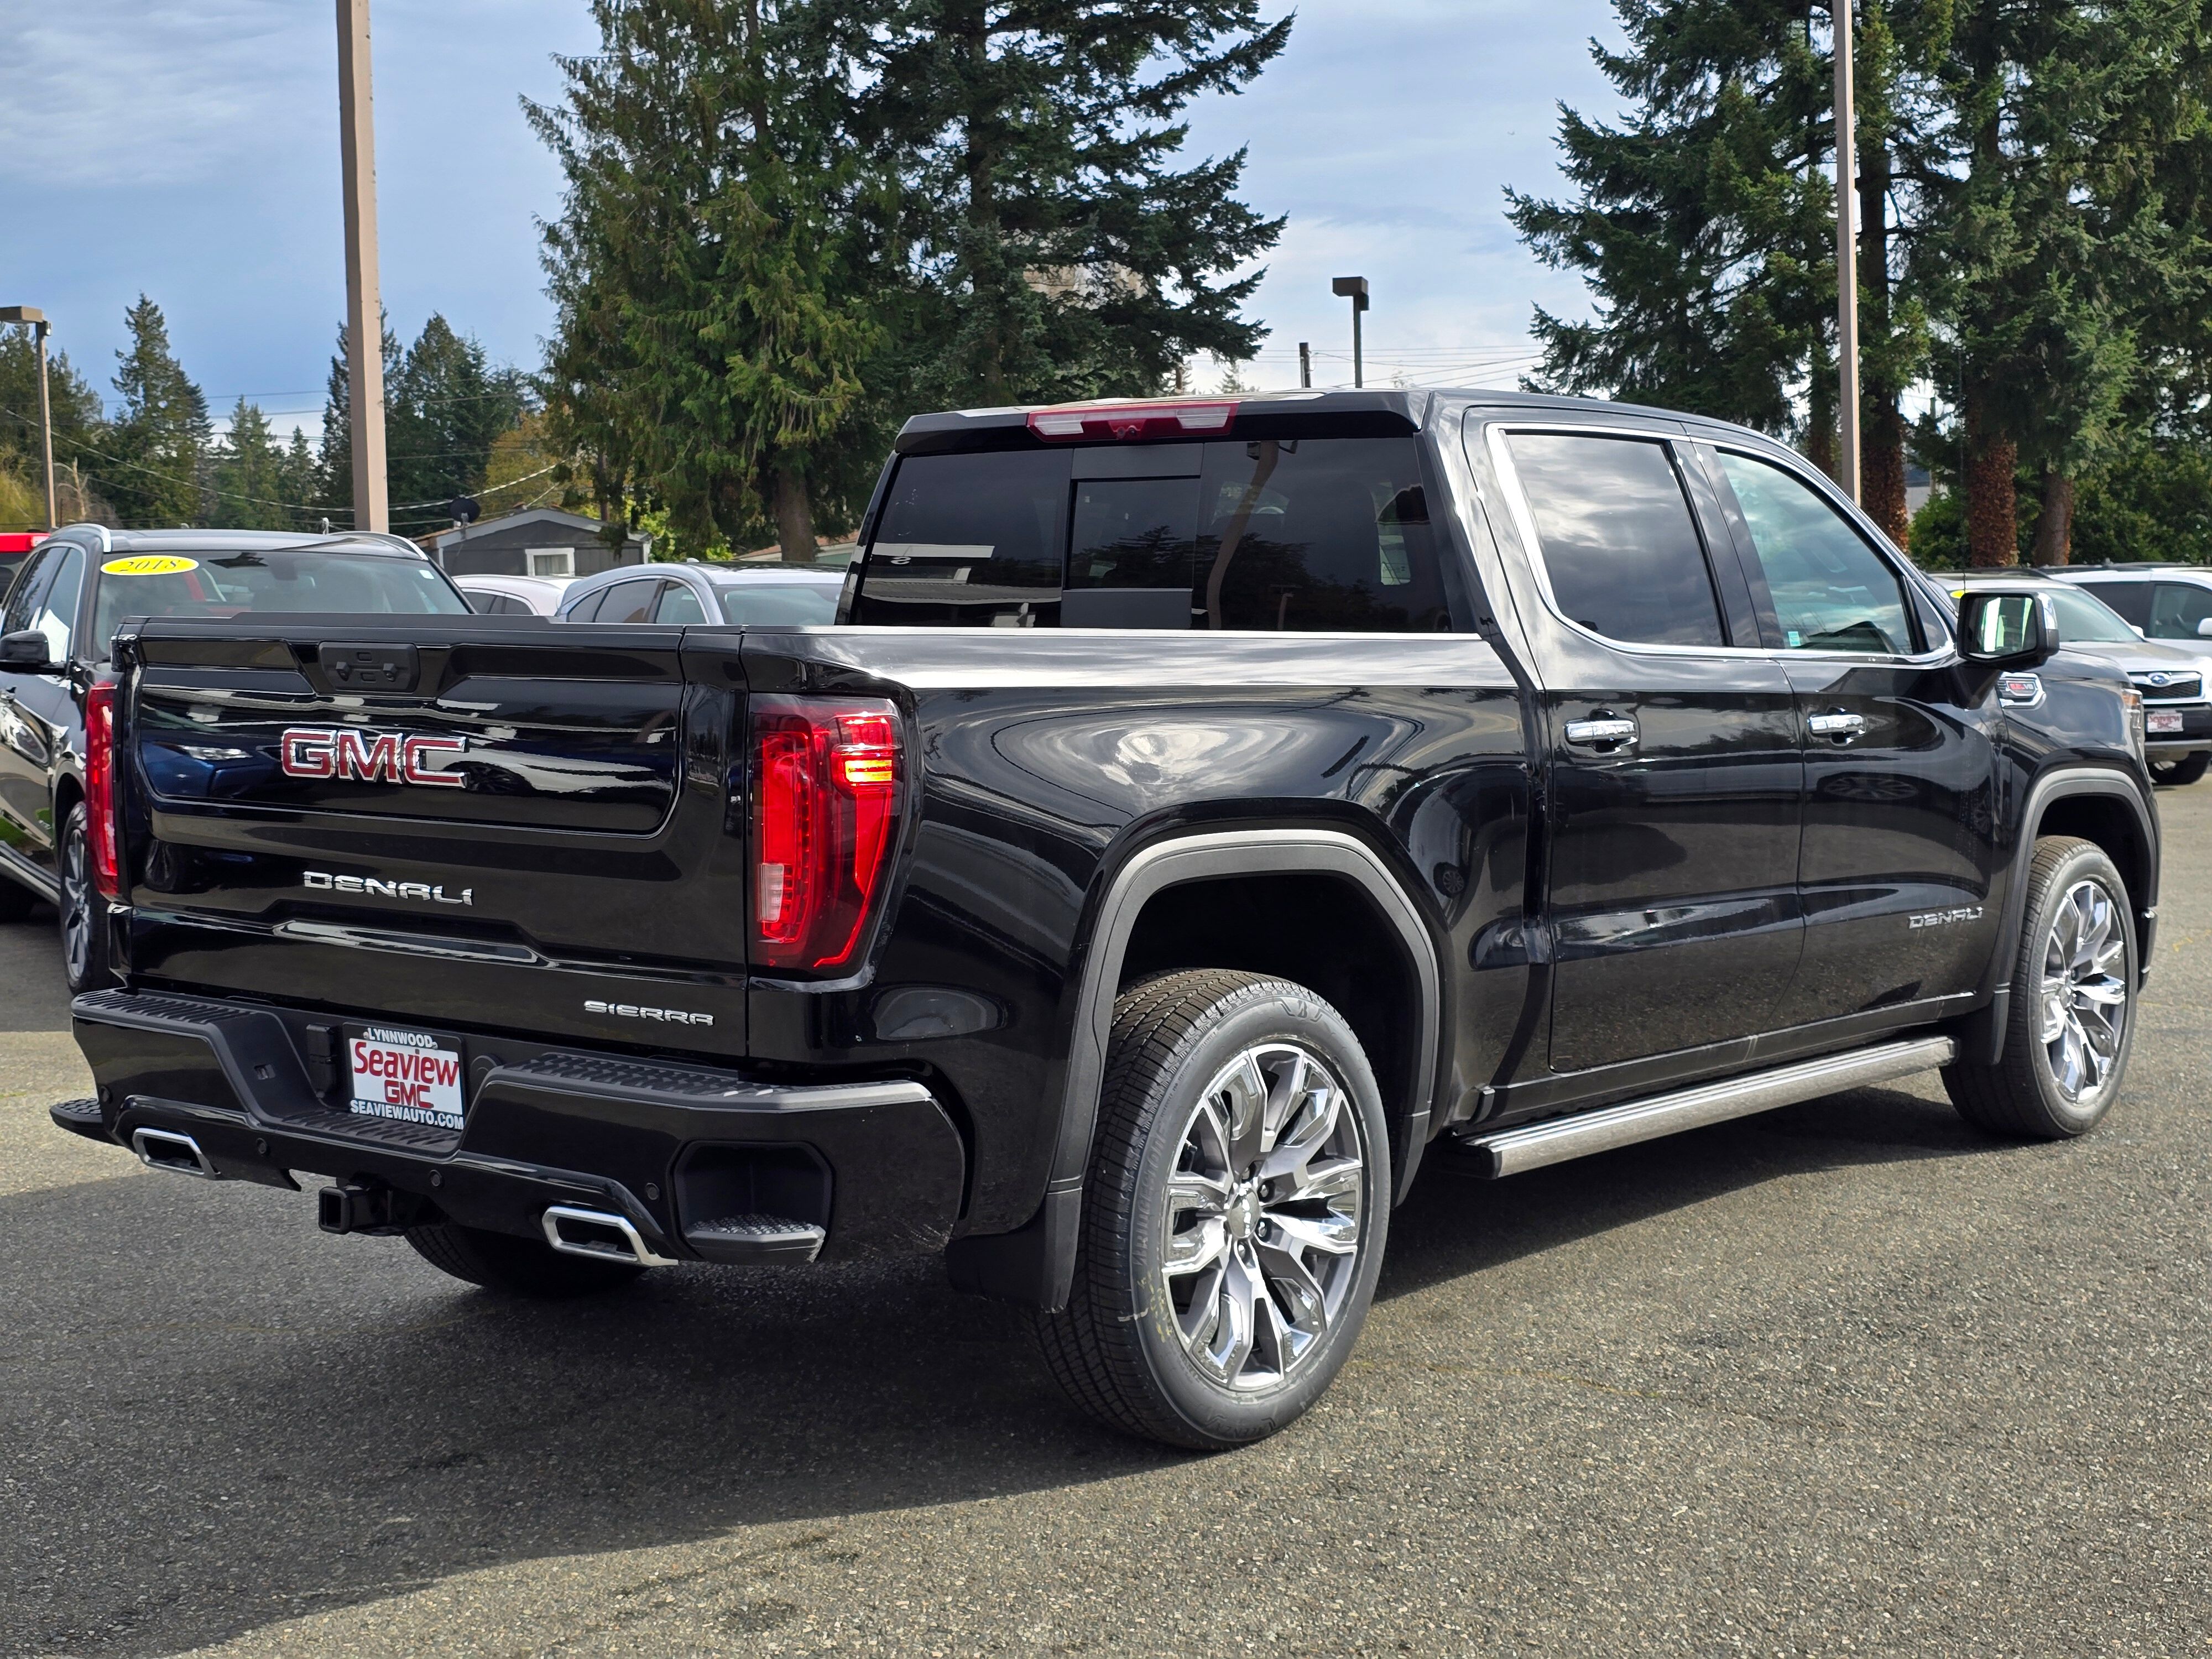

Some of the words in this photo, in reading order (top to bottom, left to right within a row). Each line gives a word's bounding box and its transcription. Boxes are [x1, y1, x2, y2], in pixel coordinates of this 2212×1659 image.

[119, 560, 181, 572] 2018
[280, 727, 469, 789] GMC
[302, 870, 473, 906] DENALI
[1909, 906, 1983, 929] DENALI
[583, 1000, 714, 1026] SIERRA
[367, 1027, 434, 1048] LYNNWOOD
[354, 1041, 459, 1087] Seaview
[384, 1079, 434, 1109] GMC
[349, 1099, 464, 1130] SEAVIEWAUTO.COM
